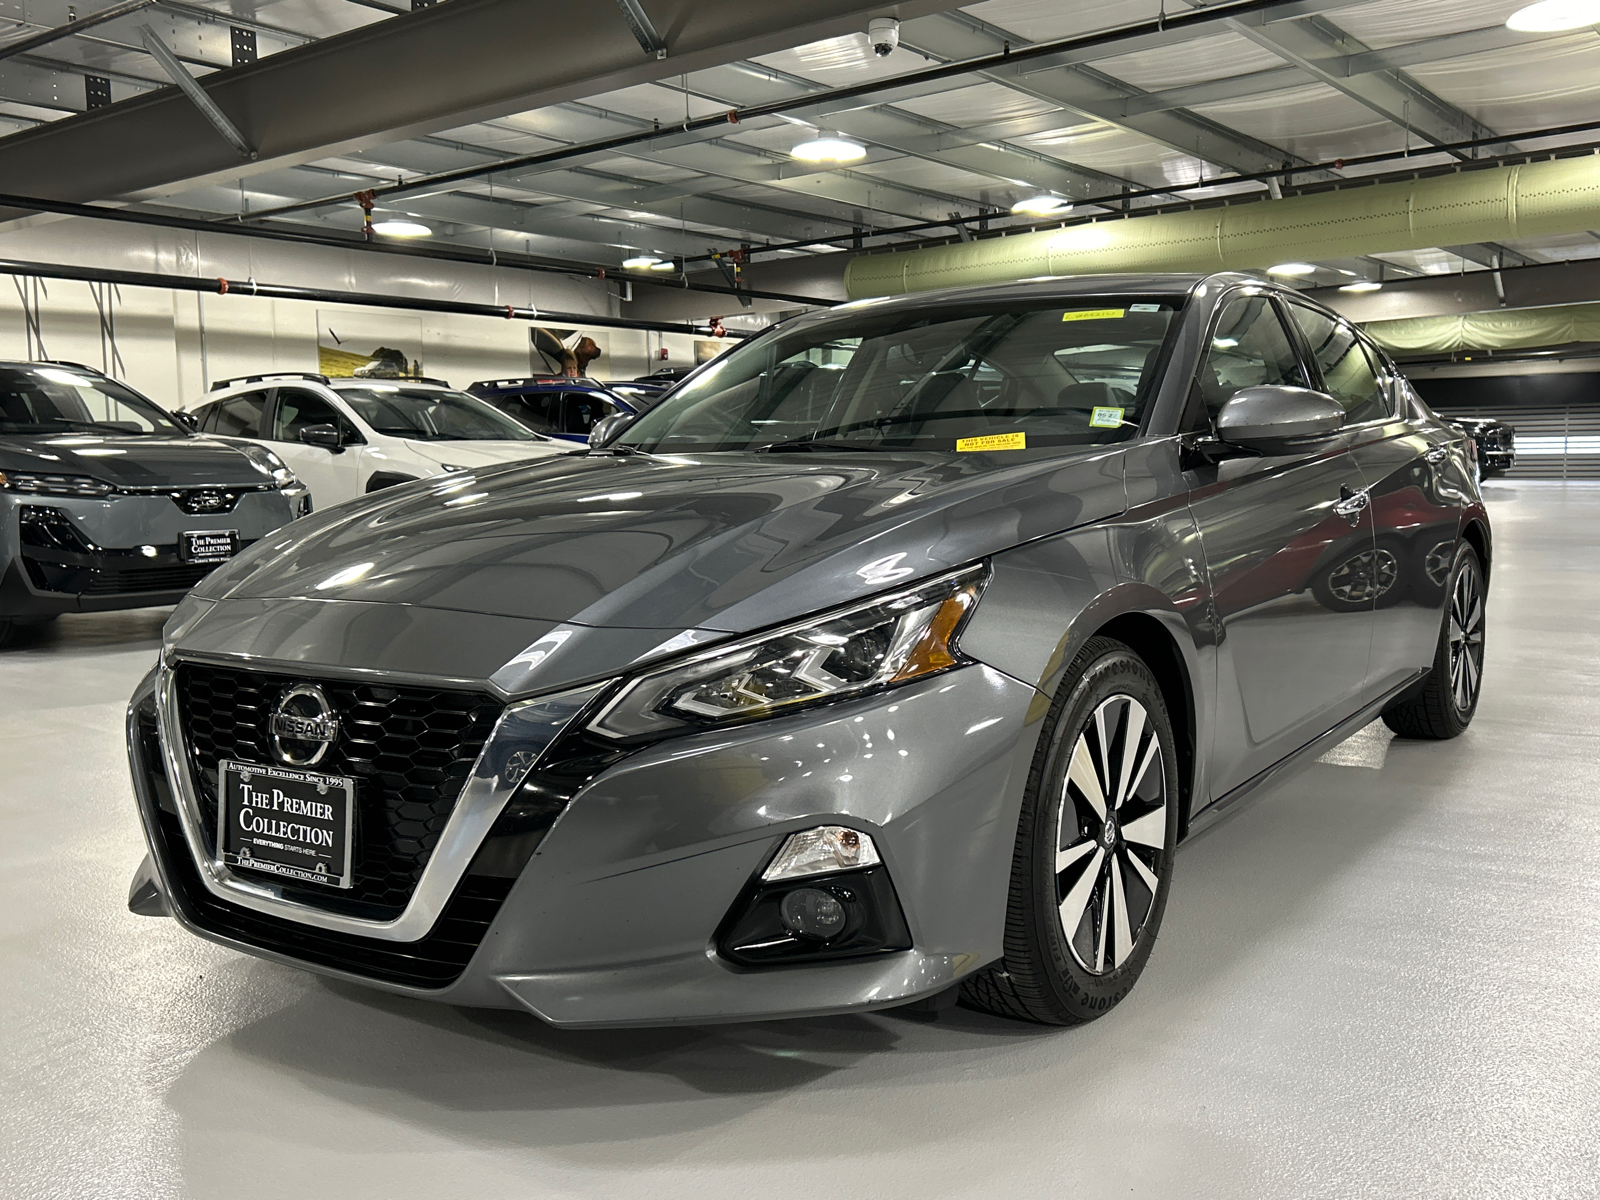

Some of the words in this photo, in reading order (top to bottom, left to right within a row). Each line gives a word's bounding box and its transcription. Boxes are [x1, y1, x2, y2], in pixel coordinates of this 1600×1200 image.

[191, 537, 205, 546] THE
[205, 537, 231, 545] PREMIER
[191, 545, 231, 553] COLLECTION
[274, 719, 327, 737] NISSAN
[228, 762, 267, 775] AUTOMOTIVE
[267, 768, 304, 780] EXCELLENCE
[305, 774, 324, 784] SINCE
[325, 777, 343, 787] 1995
[239, 784, 270, 810] THE
[272, 788, 334, 821] PREMIER
[239, 807, 334, 848] COLLECTION
[253, 837, 284, 850] EVERYTHING
[284, 842, 302, 854] STARTS
